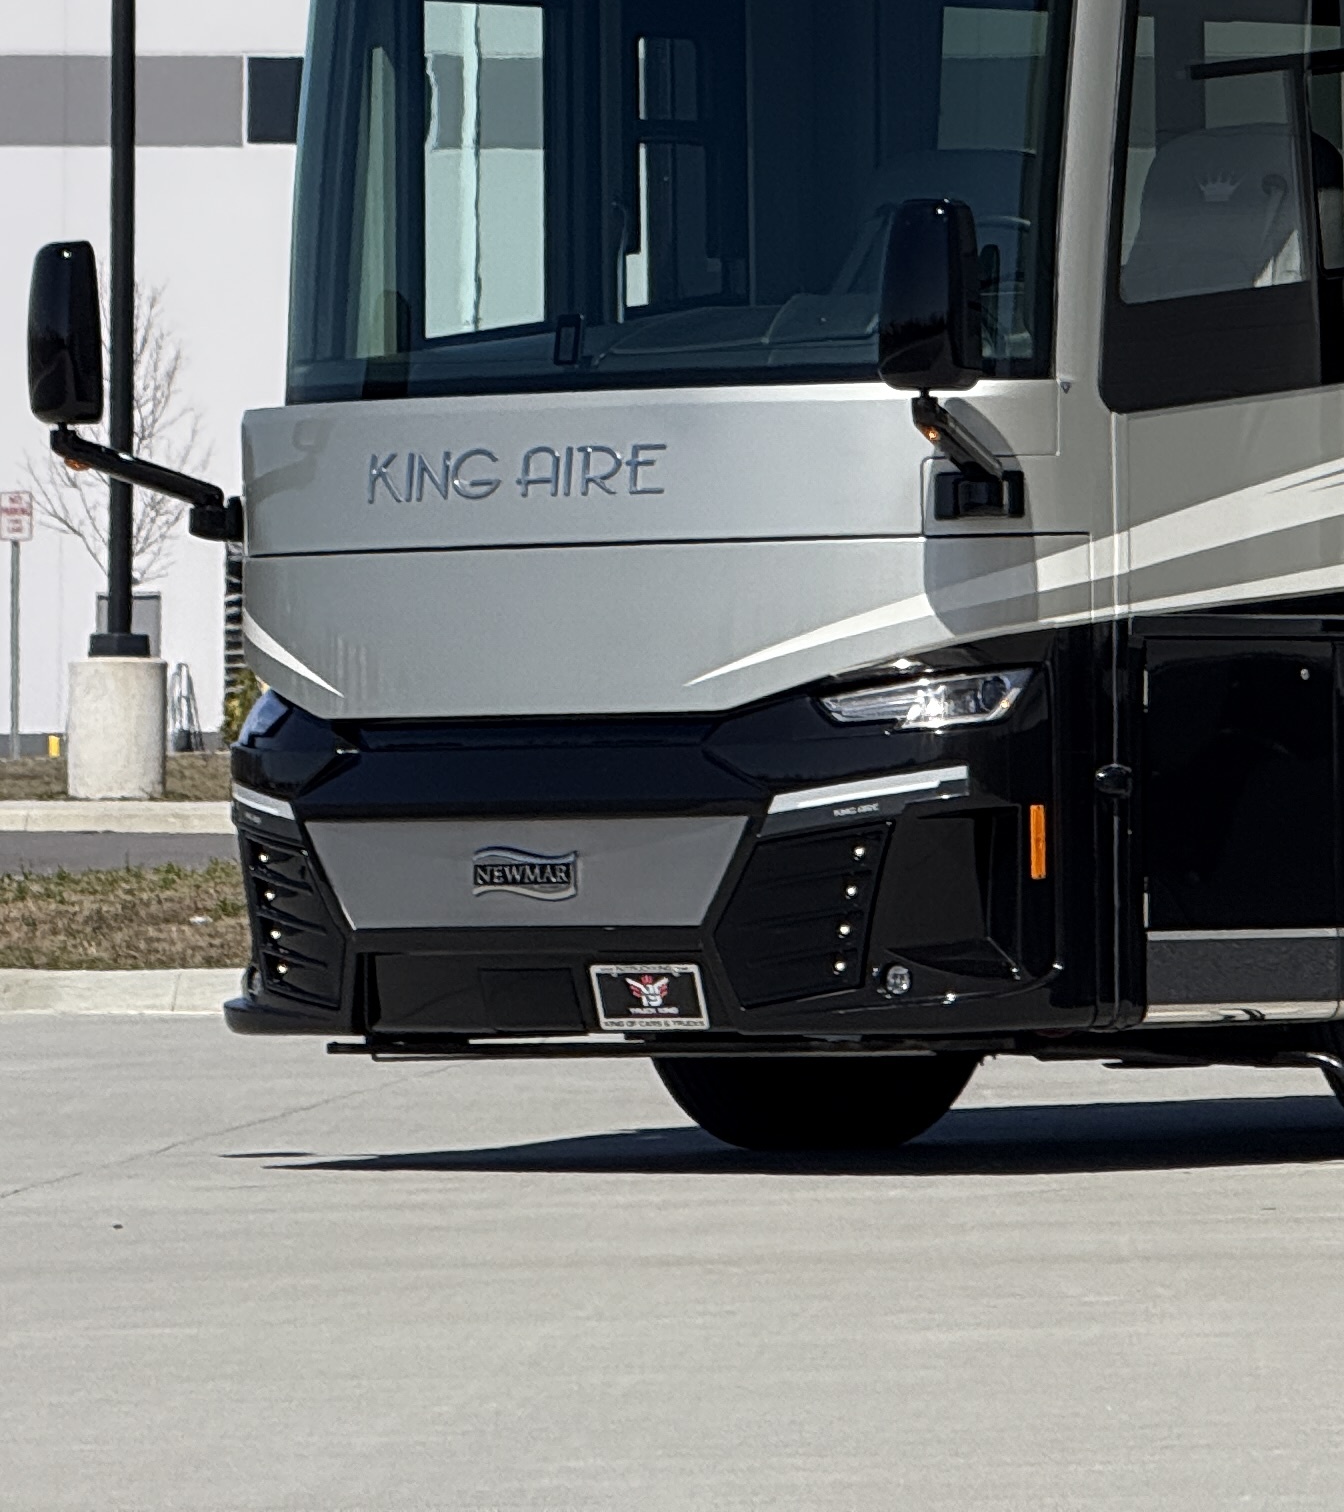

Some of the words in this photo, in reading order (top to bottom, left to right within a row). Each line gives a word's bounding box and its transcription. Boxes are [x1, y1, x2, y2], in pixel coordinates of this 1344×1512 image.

[367, 448, 502, 504] KING
[516, 443, 667, 497] AIRE
[476, 864, 569, 884] NEWMAR
